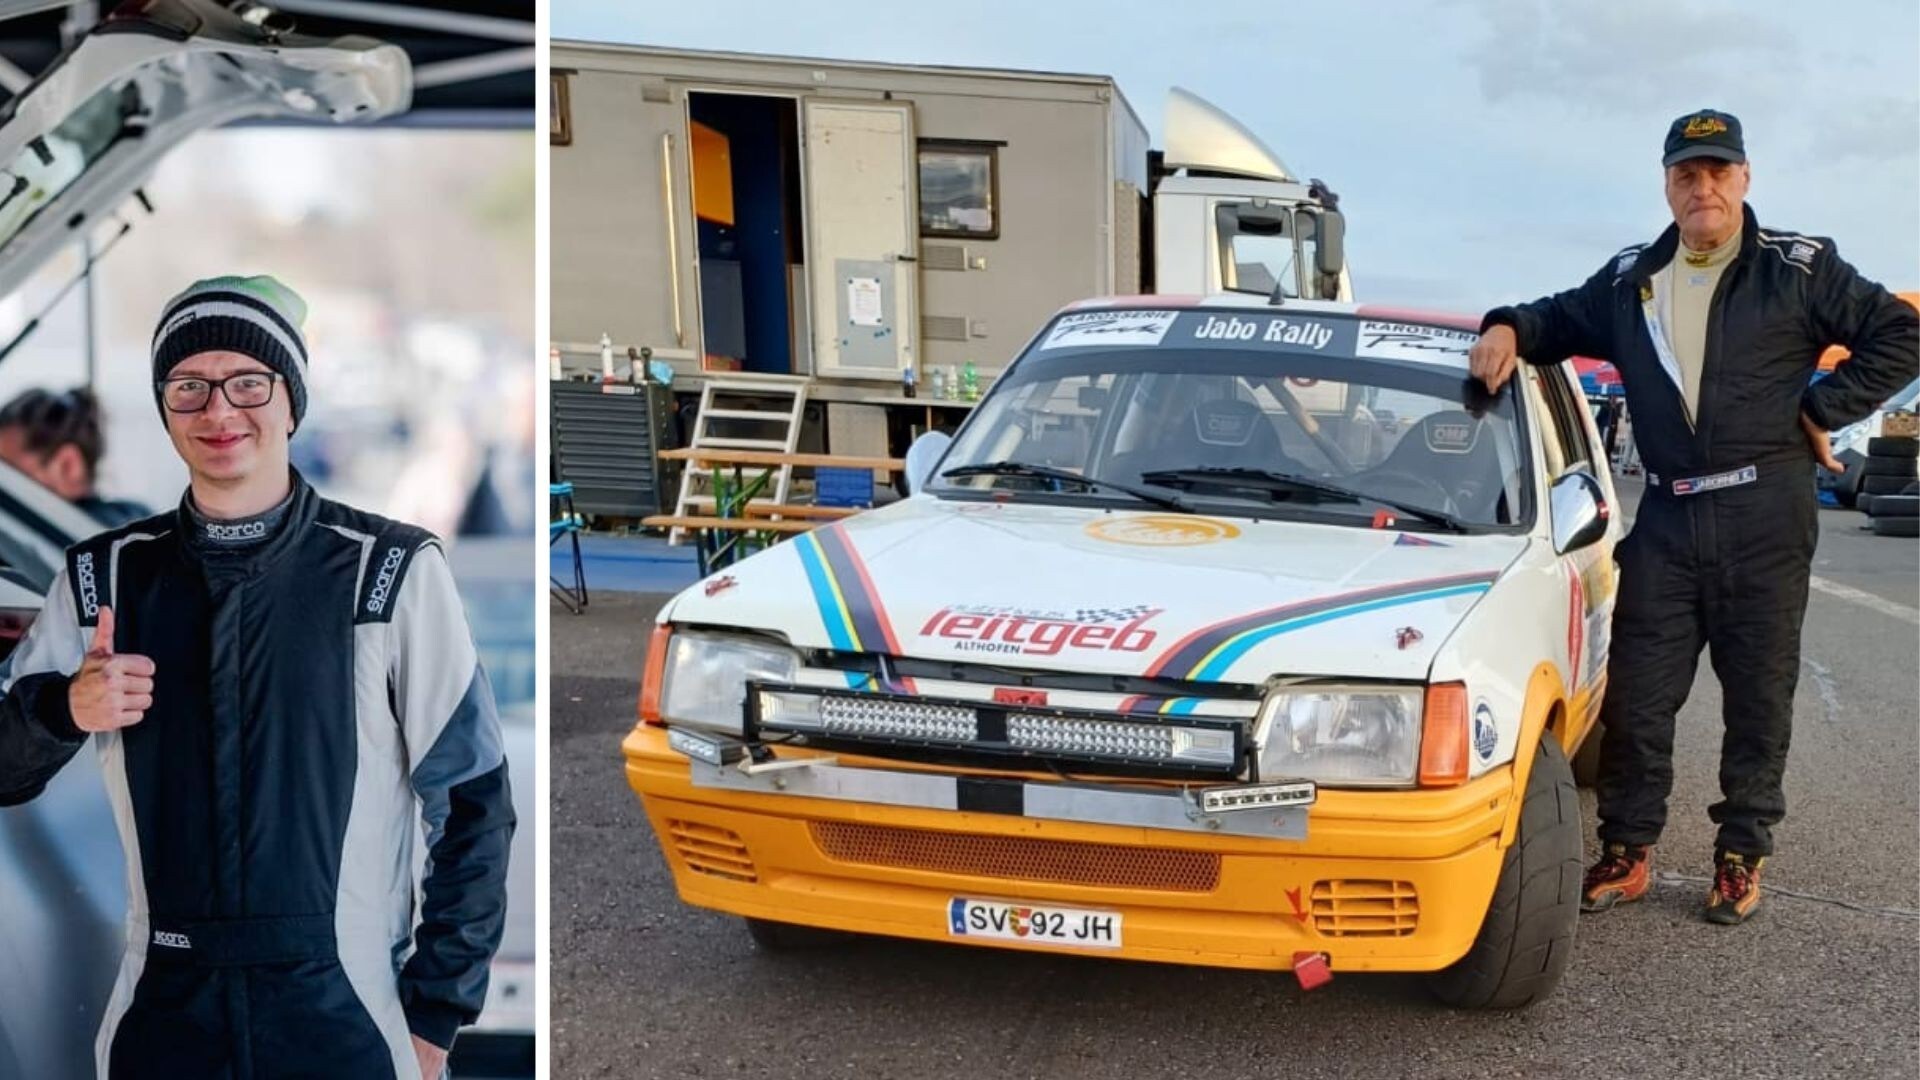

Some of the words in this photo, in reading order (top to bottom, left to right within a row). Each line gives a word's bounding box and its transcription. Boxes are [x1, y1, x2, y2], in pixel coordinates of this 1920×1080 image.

[1061, 311, 1171, 323] KAROSSERIE
[1195, 316, 1257, 340] Jabo
[1263, 318, 1333, 350] Rally
[1365, 322, 1479, 343] KAROSSERI
[205, 521, 266, 541] sparco
[76, 551, 99, 619] sparco
[366, 547, 407, 615] sparco
[918, 607, 1165, 656] leitgeb
[953, 640, 1021, 655] ALTHOFEN
[969, 905, 1008, 932] SV
[1030, 911, 1066, 937] 92
[1073, 914, 1113, 941] JH
